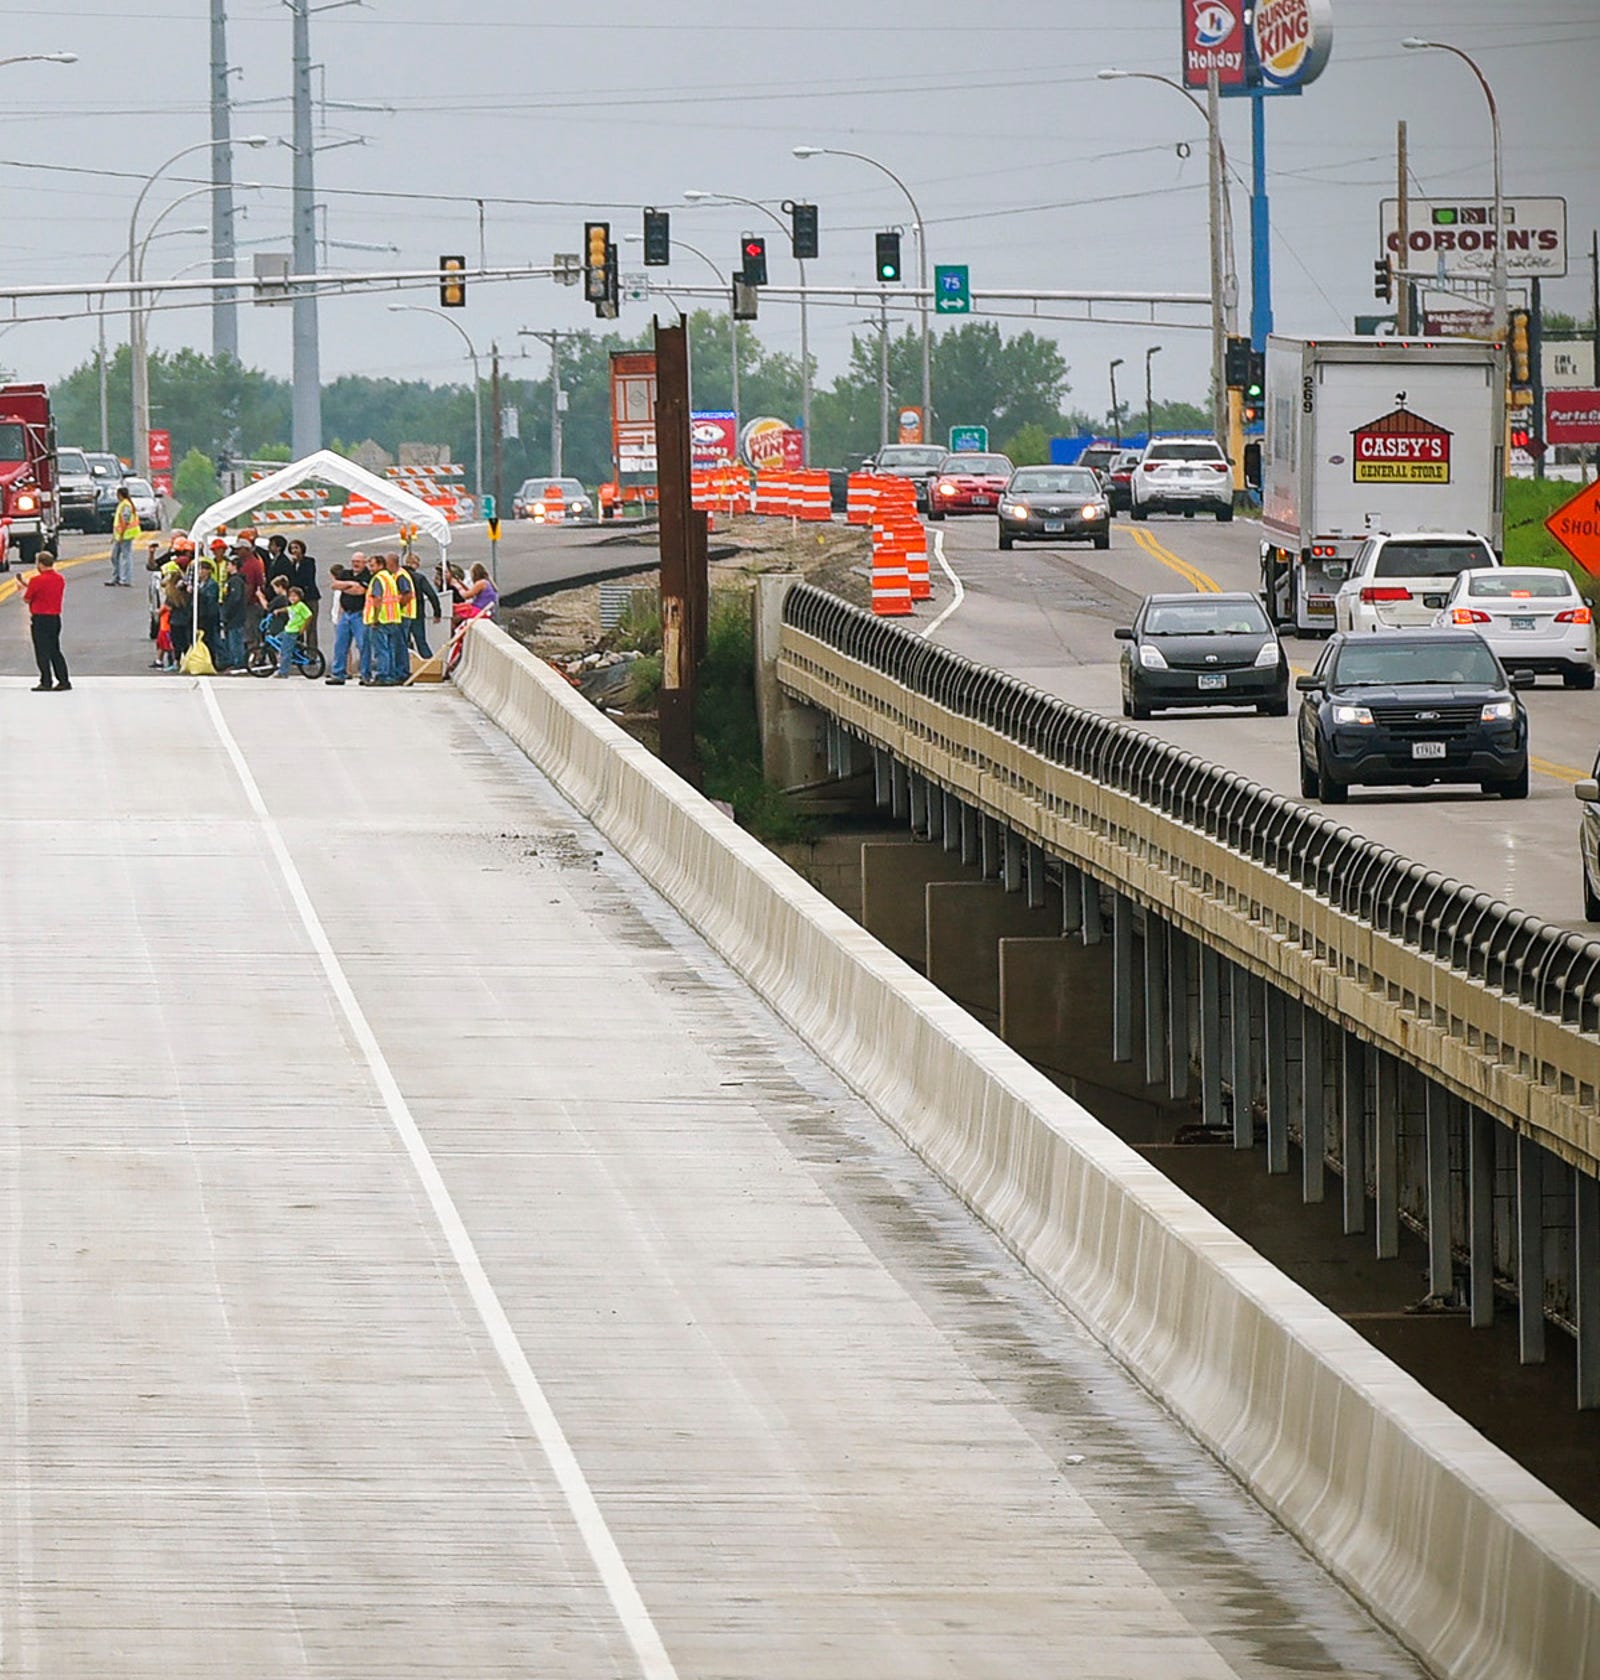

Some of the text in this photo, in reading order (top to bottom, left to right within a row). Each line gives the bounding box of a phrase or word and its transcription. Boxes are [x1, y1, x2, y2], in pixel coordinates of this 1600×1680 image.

[1260, 10, 1309, 63] KING
[1188, 49, 1242, 71] Holiday
[943, 276, 961, 290] 75
[1303, 376, 1314, 413] 269
[1361, 437, 1442, 457] CASEY'S
[1361, 465, 1443, 479] GENERAL STORE
